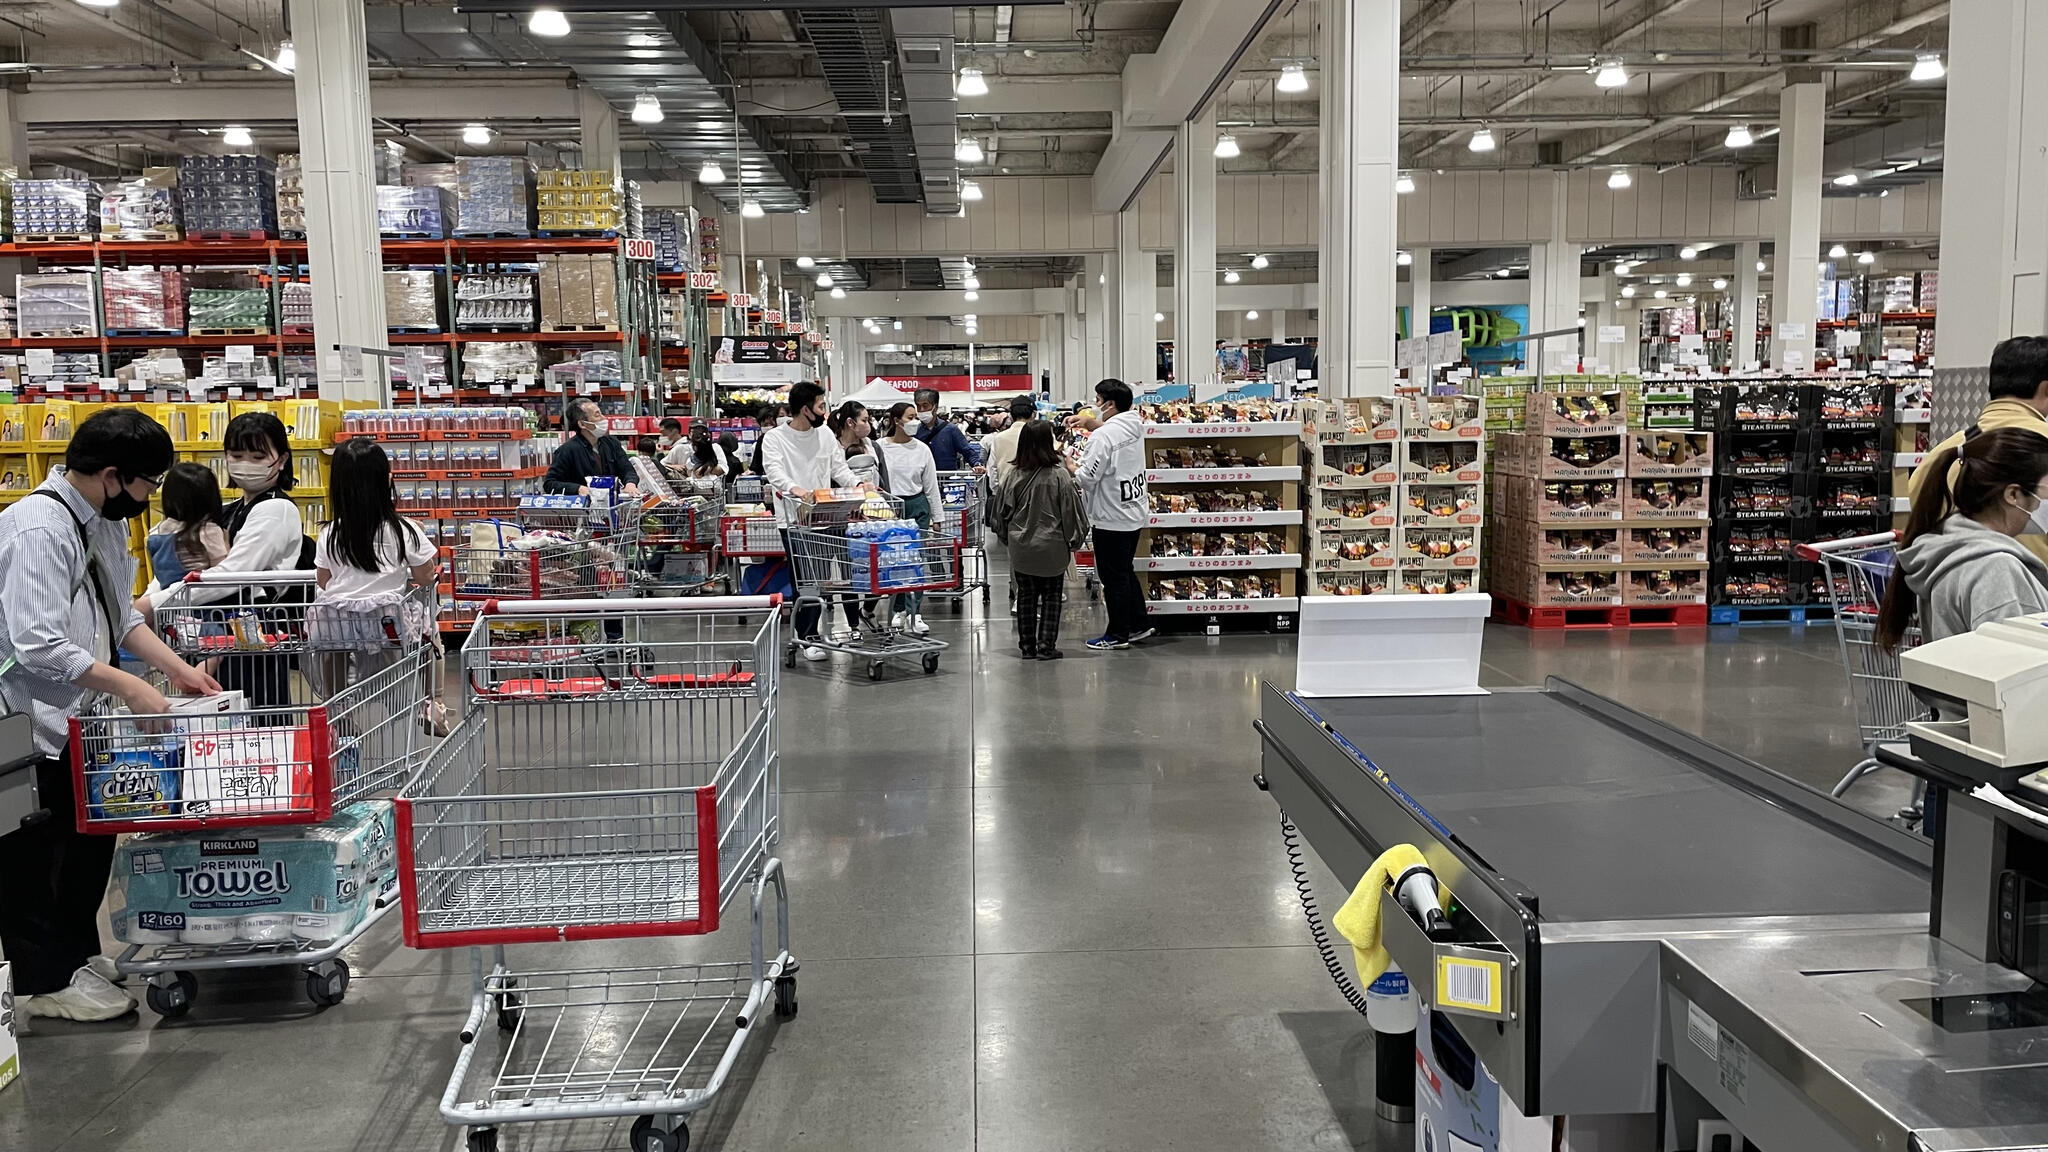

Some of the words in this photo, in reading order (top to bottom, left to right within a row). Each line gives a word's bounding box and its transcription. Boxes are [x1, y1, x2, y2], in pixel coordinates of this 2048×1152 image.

[628, 241, 653, 257] 300
[692, 274, 713, 287] 302
[733, 294, 751, 307] 304
[766, 311, 781, 322] 306
[788, 323, 802, 333] 308
[808, 333, 820, 342] 310
[822, 341, 833, 349] 312
[976, 379, 1000, 388] SUSHI
[1319, 432, 1332, 443] WILD
[1332, 431, 1345, 443] WEST
[1404, 428, 1416, 438] WILD
[1416, 428, 1429, 438] WEST
[1760, 466, 1786, 474] STRIPS
[1317, 475, 1330, 485] WILD
[1330, 475, 1343, 485] WEST
[1403, 472, 1415, 482] WILD
[1415, 472, 1428, 482] WEST
[1120, 471, 1147, 502] D3P
[1759, 510, 1785, 518] STRIPS
[1316, 518, 1328, 528] WILD
[1328, 518, 1341, 528] WEST
[1403, 515, 1416, 525] WILD
[1416, 515, 1428, 525] WEST
[1315, 559, 1328, 569] WILD
[1328, 559, 1341, 569] WEST
[1399, 557, 1412, 567] WILD
[1412, 557, 1424, 567] WEST
[102, 775, 160, 799] CLEAN
[203, 841, 257, 850] KIRKLAND
[201, 860, 264, 870] PREMIUM
[173, 861, 290, 895] Towel
